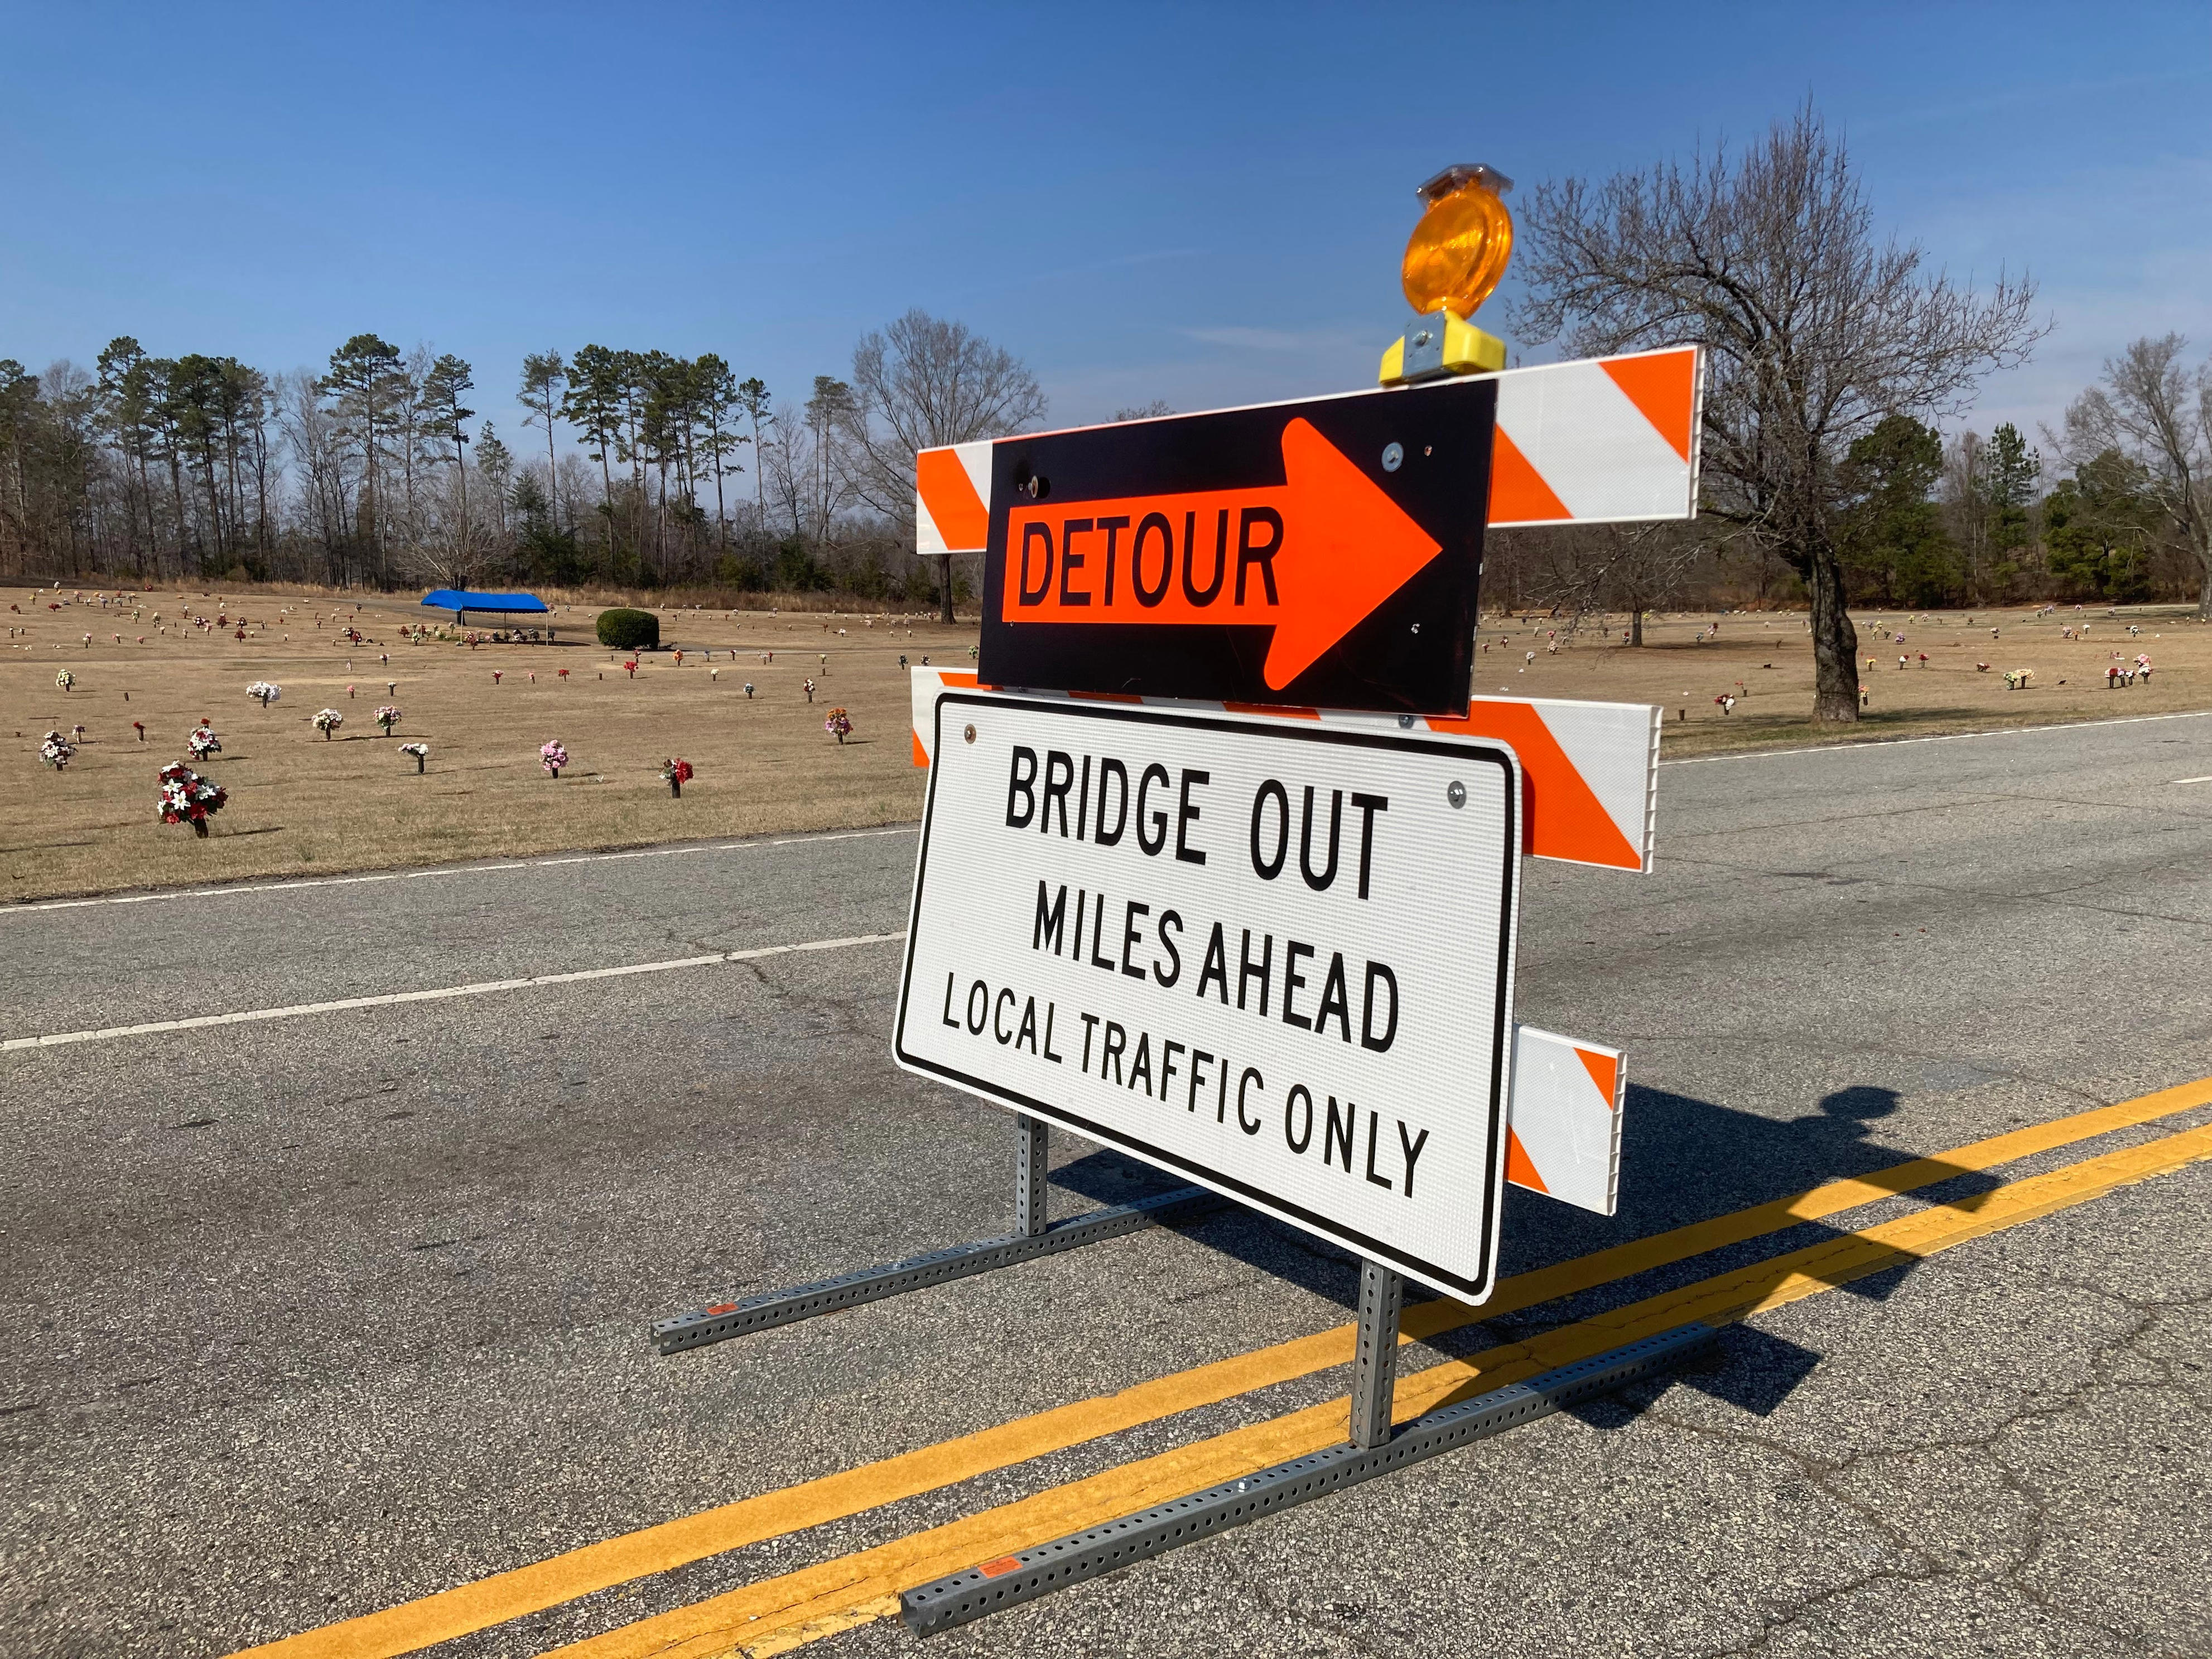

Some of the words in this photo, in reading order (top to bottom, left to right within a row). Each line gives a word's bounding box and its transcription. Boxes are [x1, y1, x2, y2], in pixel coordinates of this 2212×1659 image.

[1019, 506, 1284, 607] DETOUR
[1005, 745, 1211, 866] BRIDGE
[1250, 778, 1389, 901] OUT
[1032, 879, 1184, 988] MILES
[1196, 920, 1399, 1054] AHEAD
[942, 972, 1063, 1064] LOCAL
[1080, 1012, 1264, 1136] TRAFFIC
[1284, 1083, 1430, 1199] ONLY
